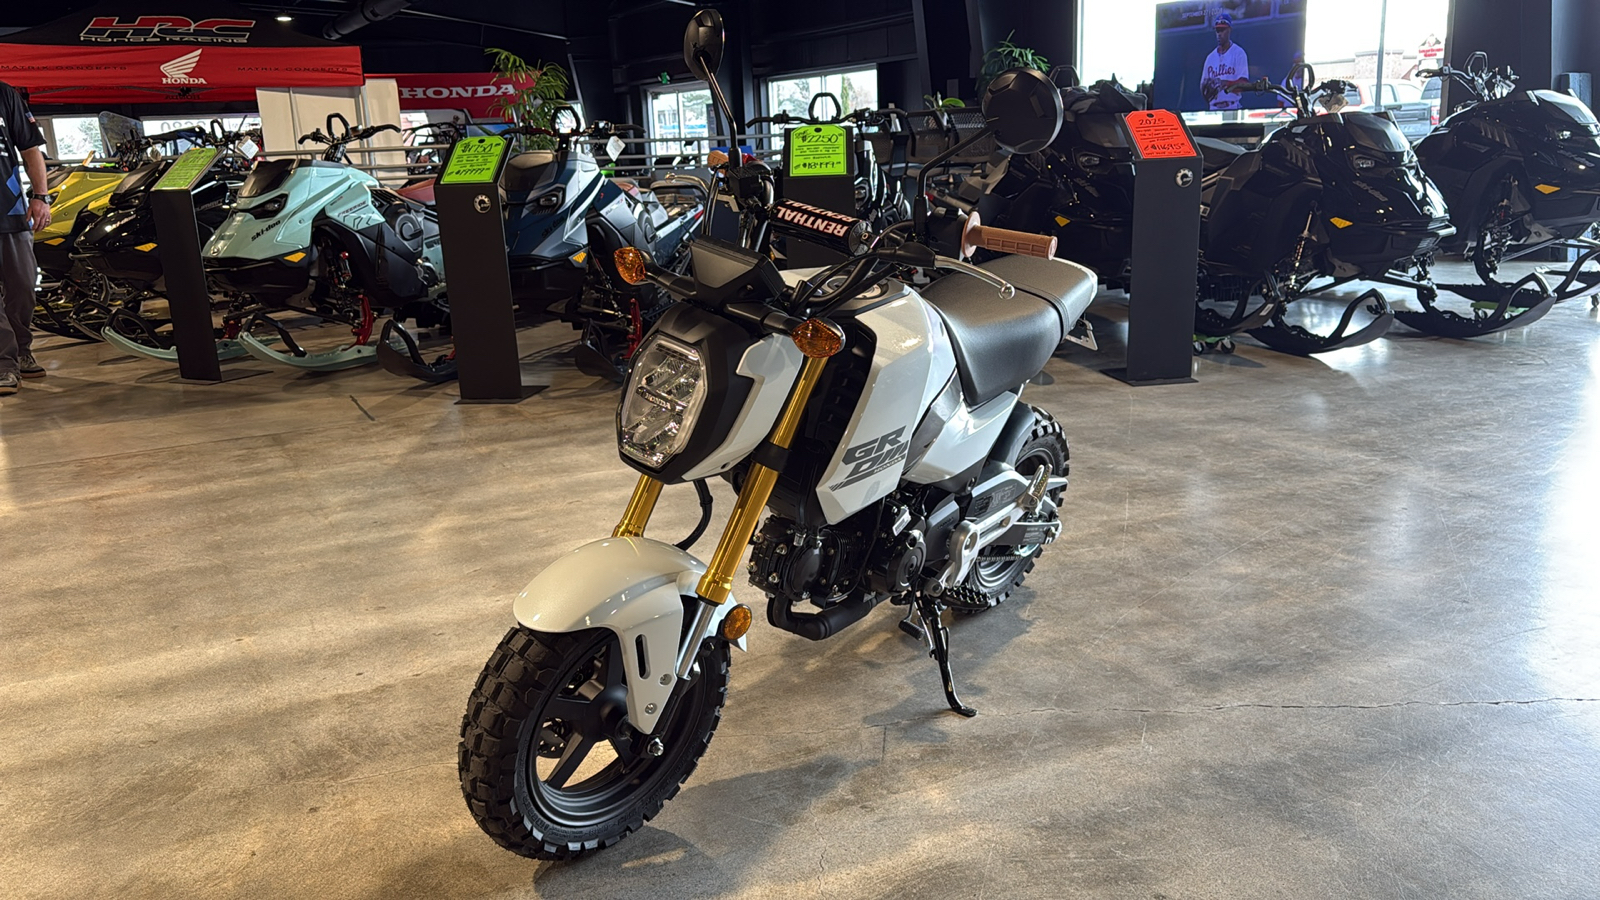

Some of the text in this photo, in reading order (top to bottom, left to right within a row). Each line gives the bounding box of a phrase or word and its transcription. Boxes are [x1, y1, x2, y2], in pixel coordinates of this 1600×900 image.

[80, 16, 256, 38] HRC
[1207, 64, 1236, 79] Phillies
[400, 84, 516, 99] HONDA
[1138, 117, 1165, 126] 2025
[251, 220, 281, 242] ski-doo
[776, 206, 850, 238] RENTHAL
[644, 393, 671, 410] HONDA
[841, 425, 907, 466] GR
